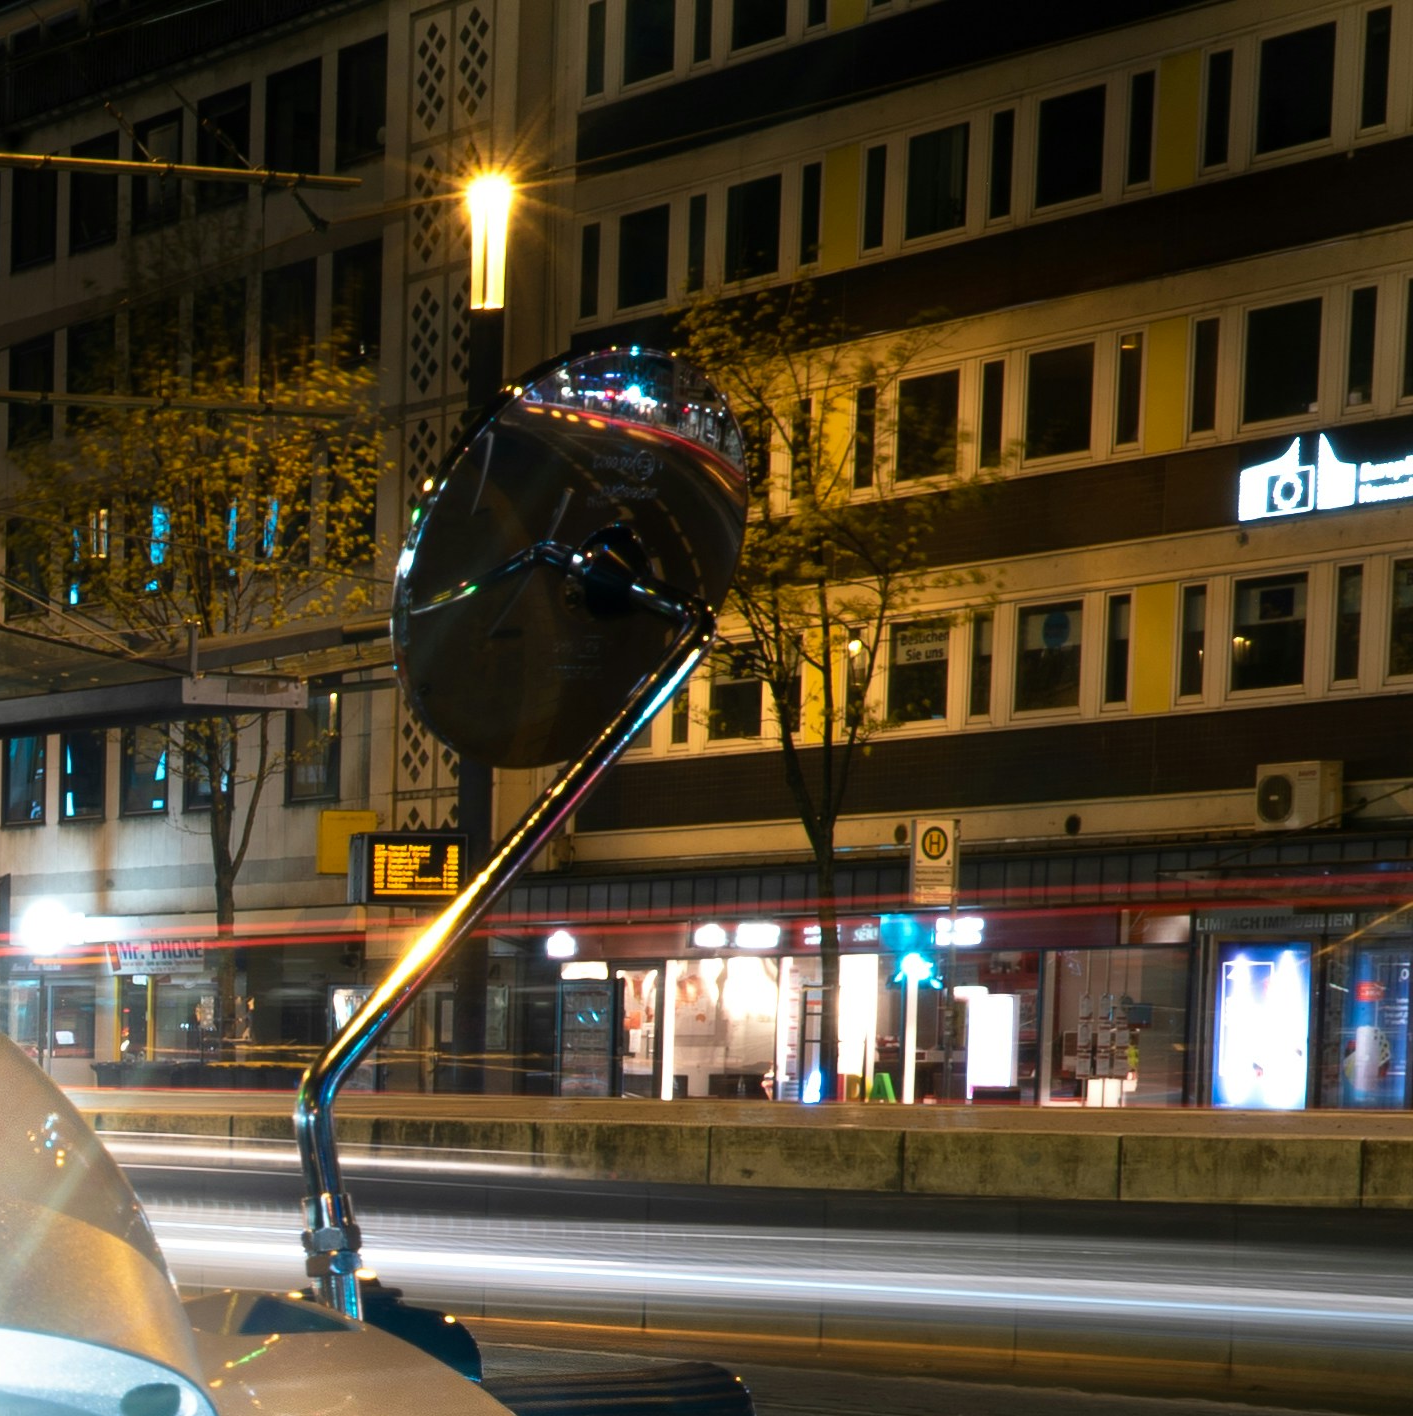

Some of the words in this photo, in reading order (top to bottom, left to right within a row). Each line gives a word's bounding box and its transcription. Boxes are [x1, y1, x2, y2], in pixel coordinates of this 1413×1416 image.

[906, 648, 922, 661] Sie
[925, 647, 944, 659] uns
[929, 834, 941, 853] H
[1263, 913, 1354, 929] IMMOBILIEN
[119, 942, 145, 960] Mr.
[150, 941, 203, 959] PHONE
